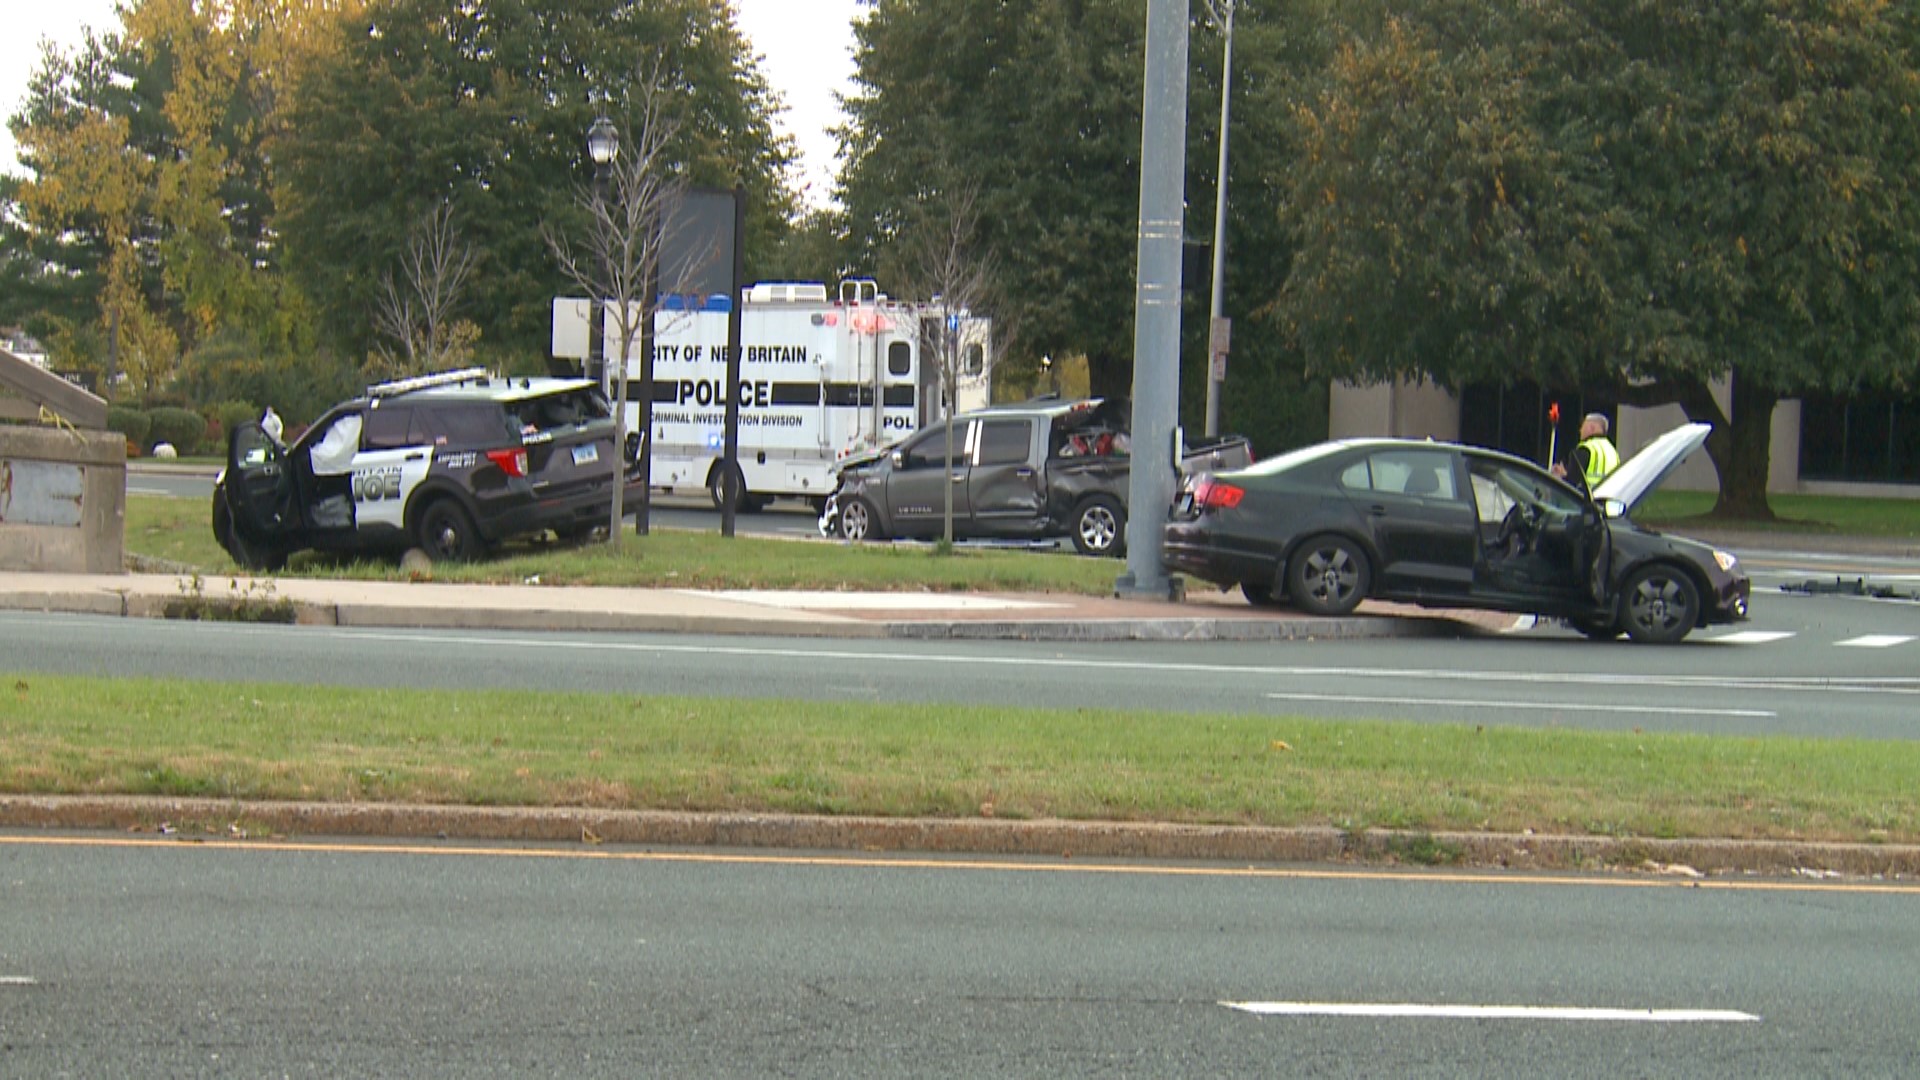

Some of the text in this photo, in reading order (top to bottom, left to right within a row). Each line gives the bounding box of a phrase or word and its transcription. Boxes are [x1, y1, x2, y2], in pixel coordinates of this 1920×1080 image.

[683, 345, 702, 362] OF
[711, 345, 742, 362] NE
[748, 345, 807, 363] BRITAIN
[680, 379, 769, 407] POLCE
[693, 412, 760, 426] INVESTTION
[762, 413, 803, 427] DIVISION
[883, 416, 914, 430] POL
